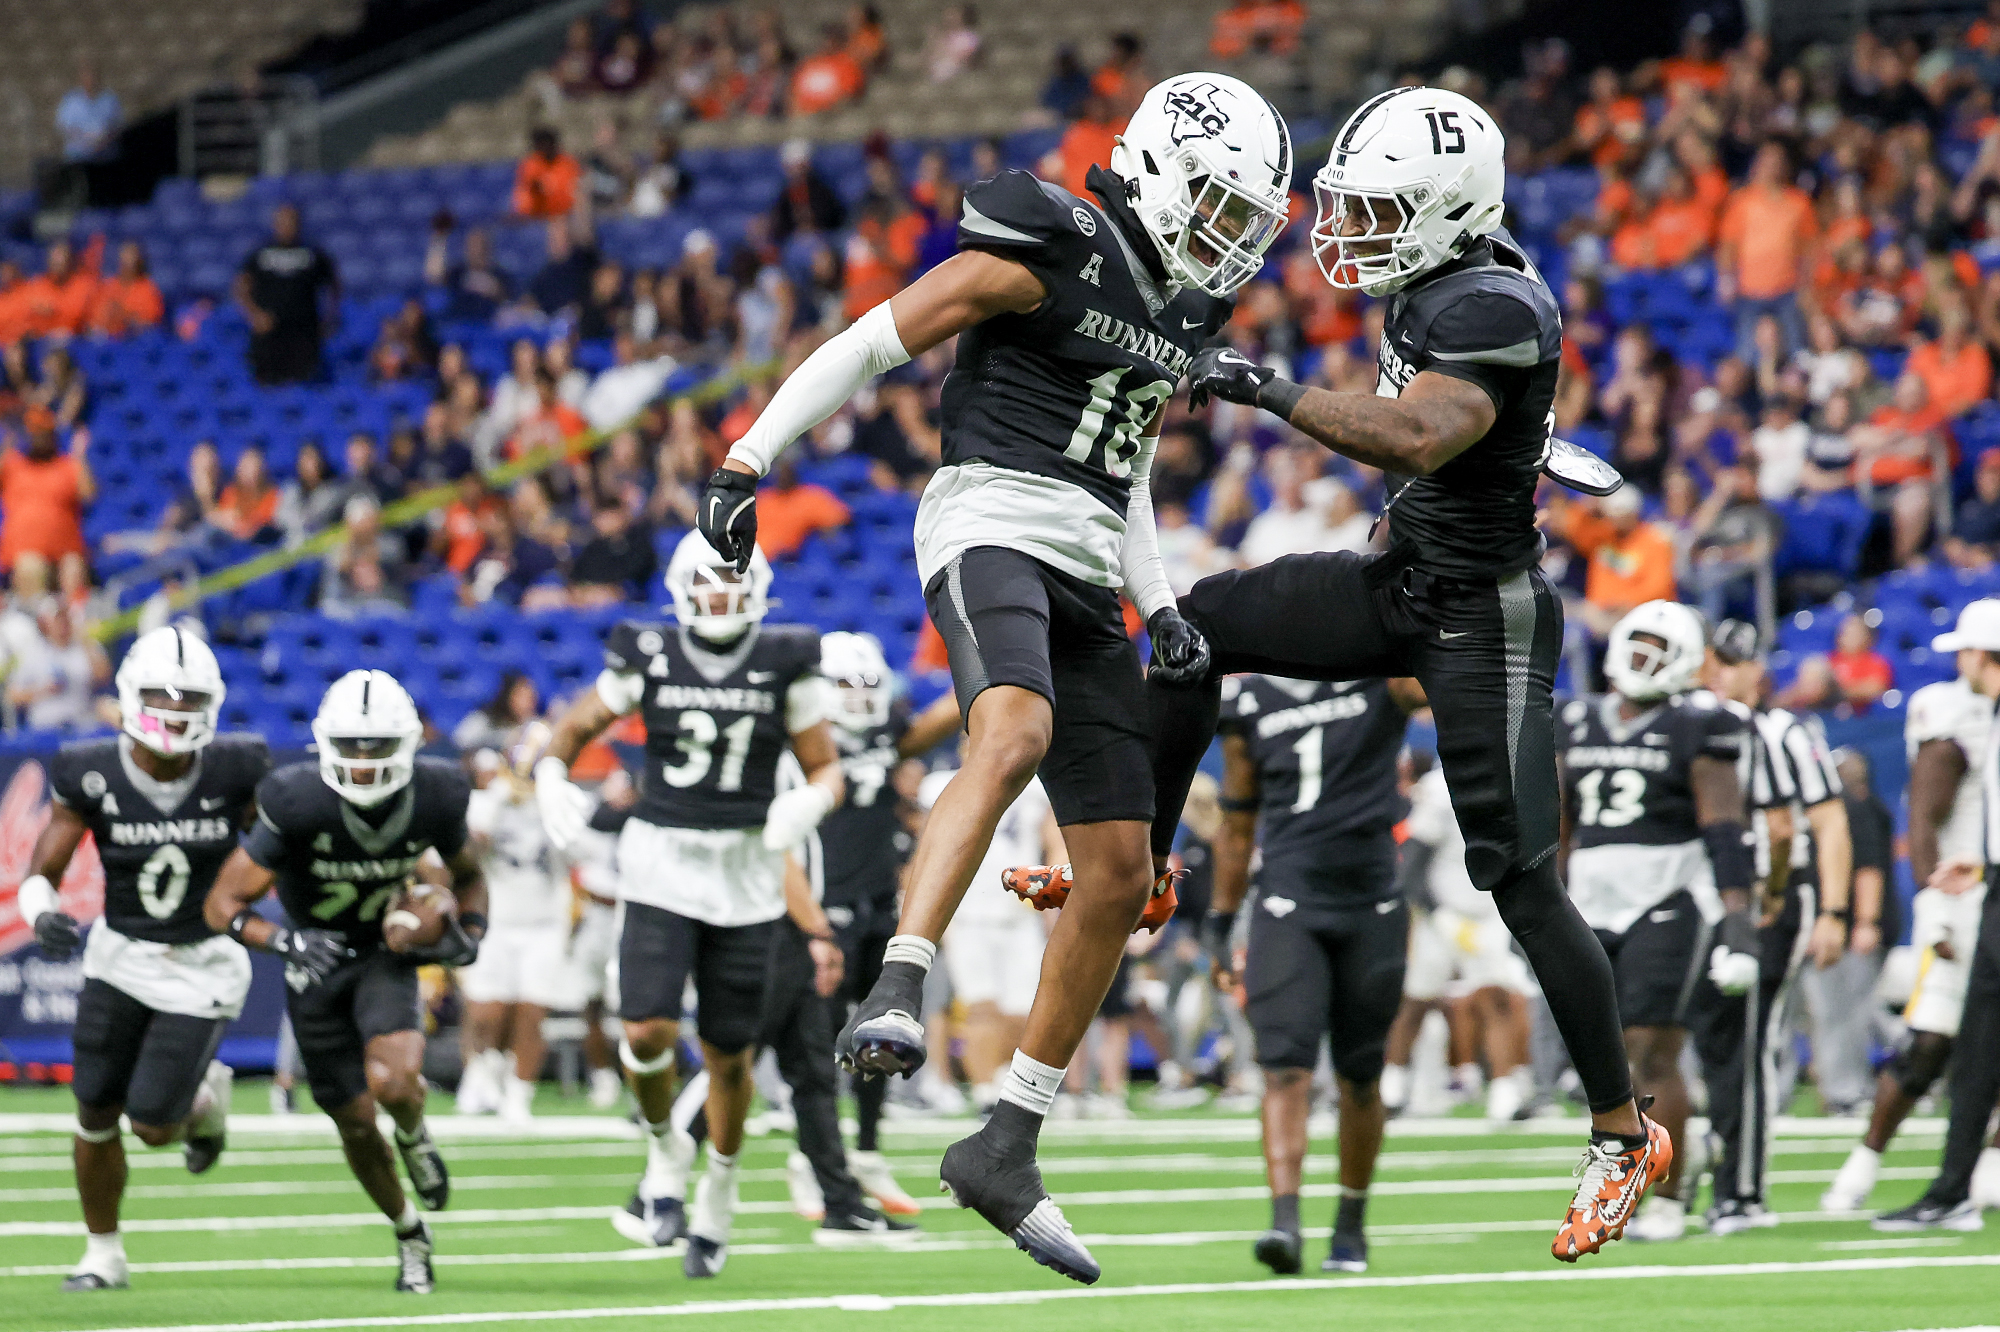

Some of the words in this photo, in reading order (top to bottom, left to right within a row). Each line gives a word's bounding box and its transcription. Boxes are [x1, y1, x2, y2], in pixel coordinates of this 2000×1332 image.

[1425, 111, 1466, 155] 15
[1263, 187, 1284, 203] 210
[1063, 366, 1174, 479] 18
[662, 709, 757, 792] 31
[1290, 724, 1325, 814] 1
[1575, 768, 1647, 828] 13
[110, 817, 230, 845] RUNNERS
[137, 843, 191, 920] 0
[310, 858, 418, 881] RUNNER
